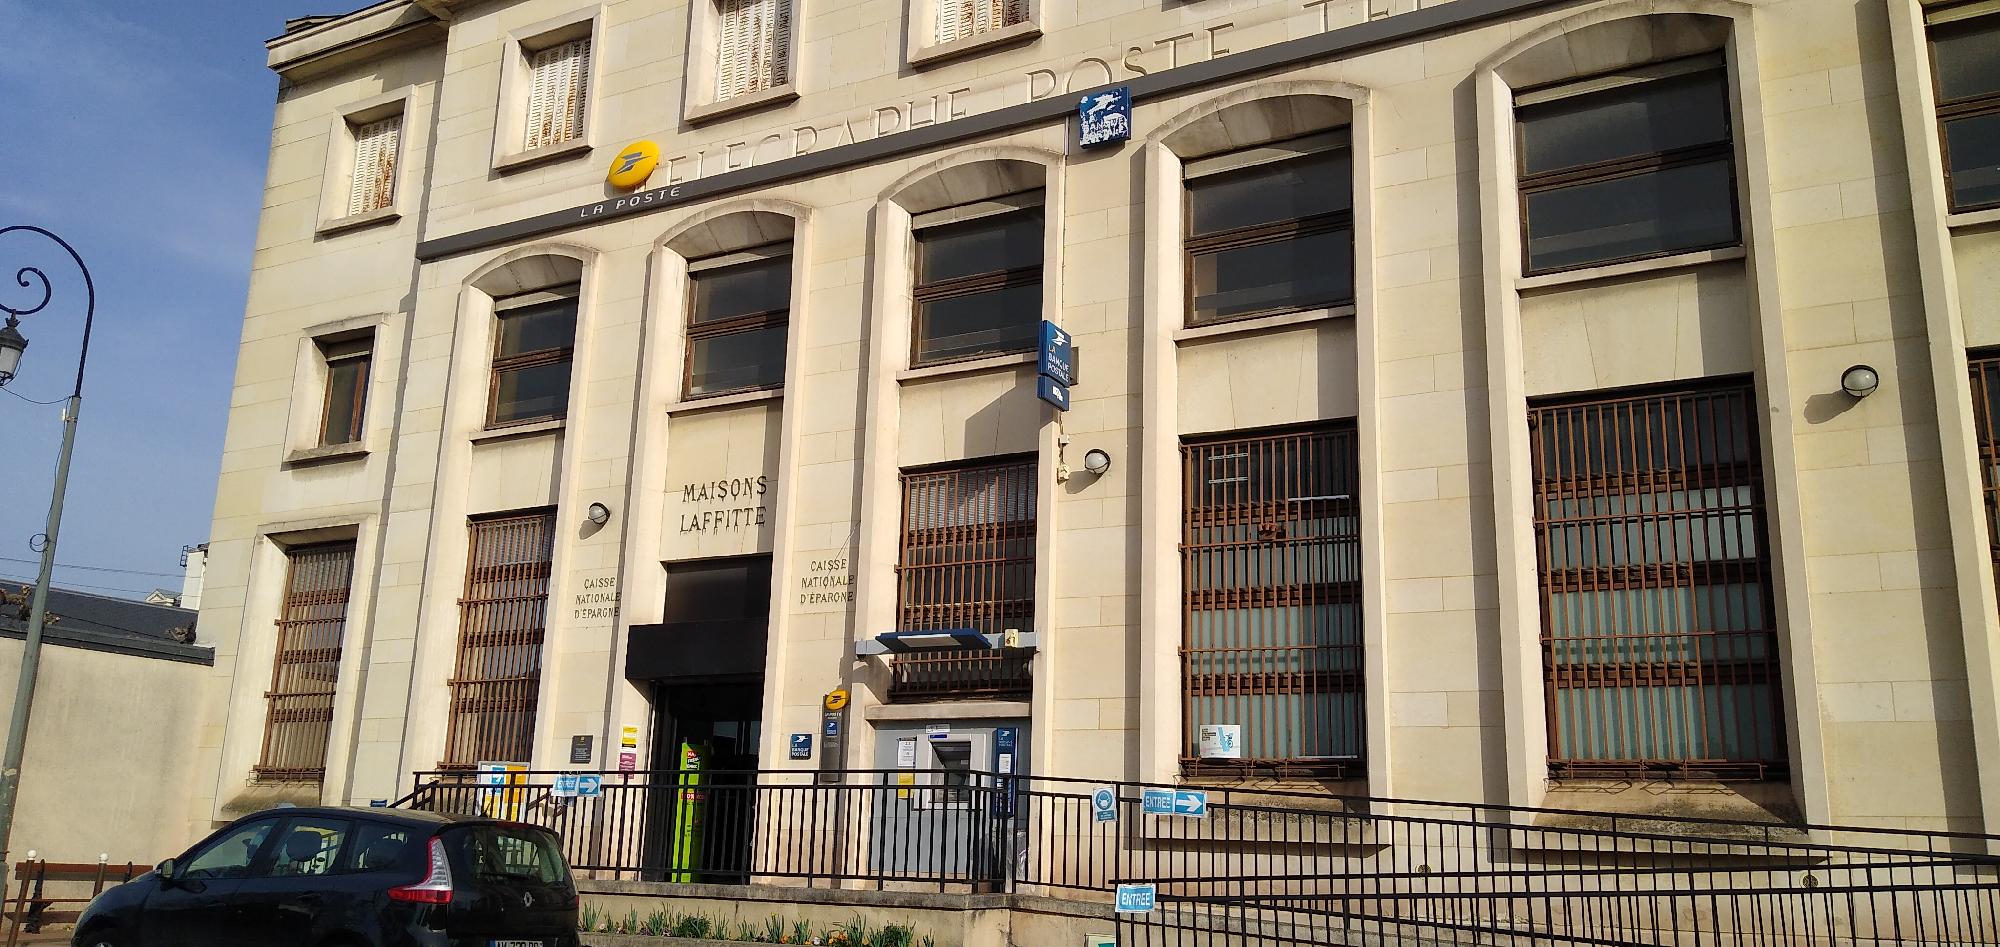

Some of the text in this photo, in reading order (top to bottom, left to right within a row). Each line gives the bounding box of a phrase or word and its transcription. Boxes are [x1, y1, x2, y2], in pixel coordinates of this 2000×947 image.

[580, 186, 682, 218] LA POSTE
[1048, 344, 1056, 354] LA
[1047, 362, 1069, 382] POSTALE
[682, 475, 767, 502] MAISONS
[680, 506, 767, 532] LAFFITTE
[810, 559, 847, 571] CAISSE
[584, 577, 616, 589] CAISSE
[801, 574, 855, 588] NATIONALE
[575, 592, 621, 605] NATIONALE
